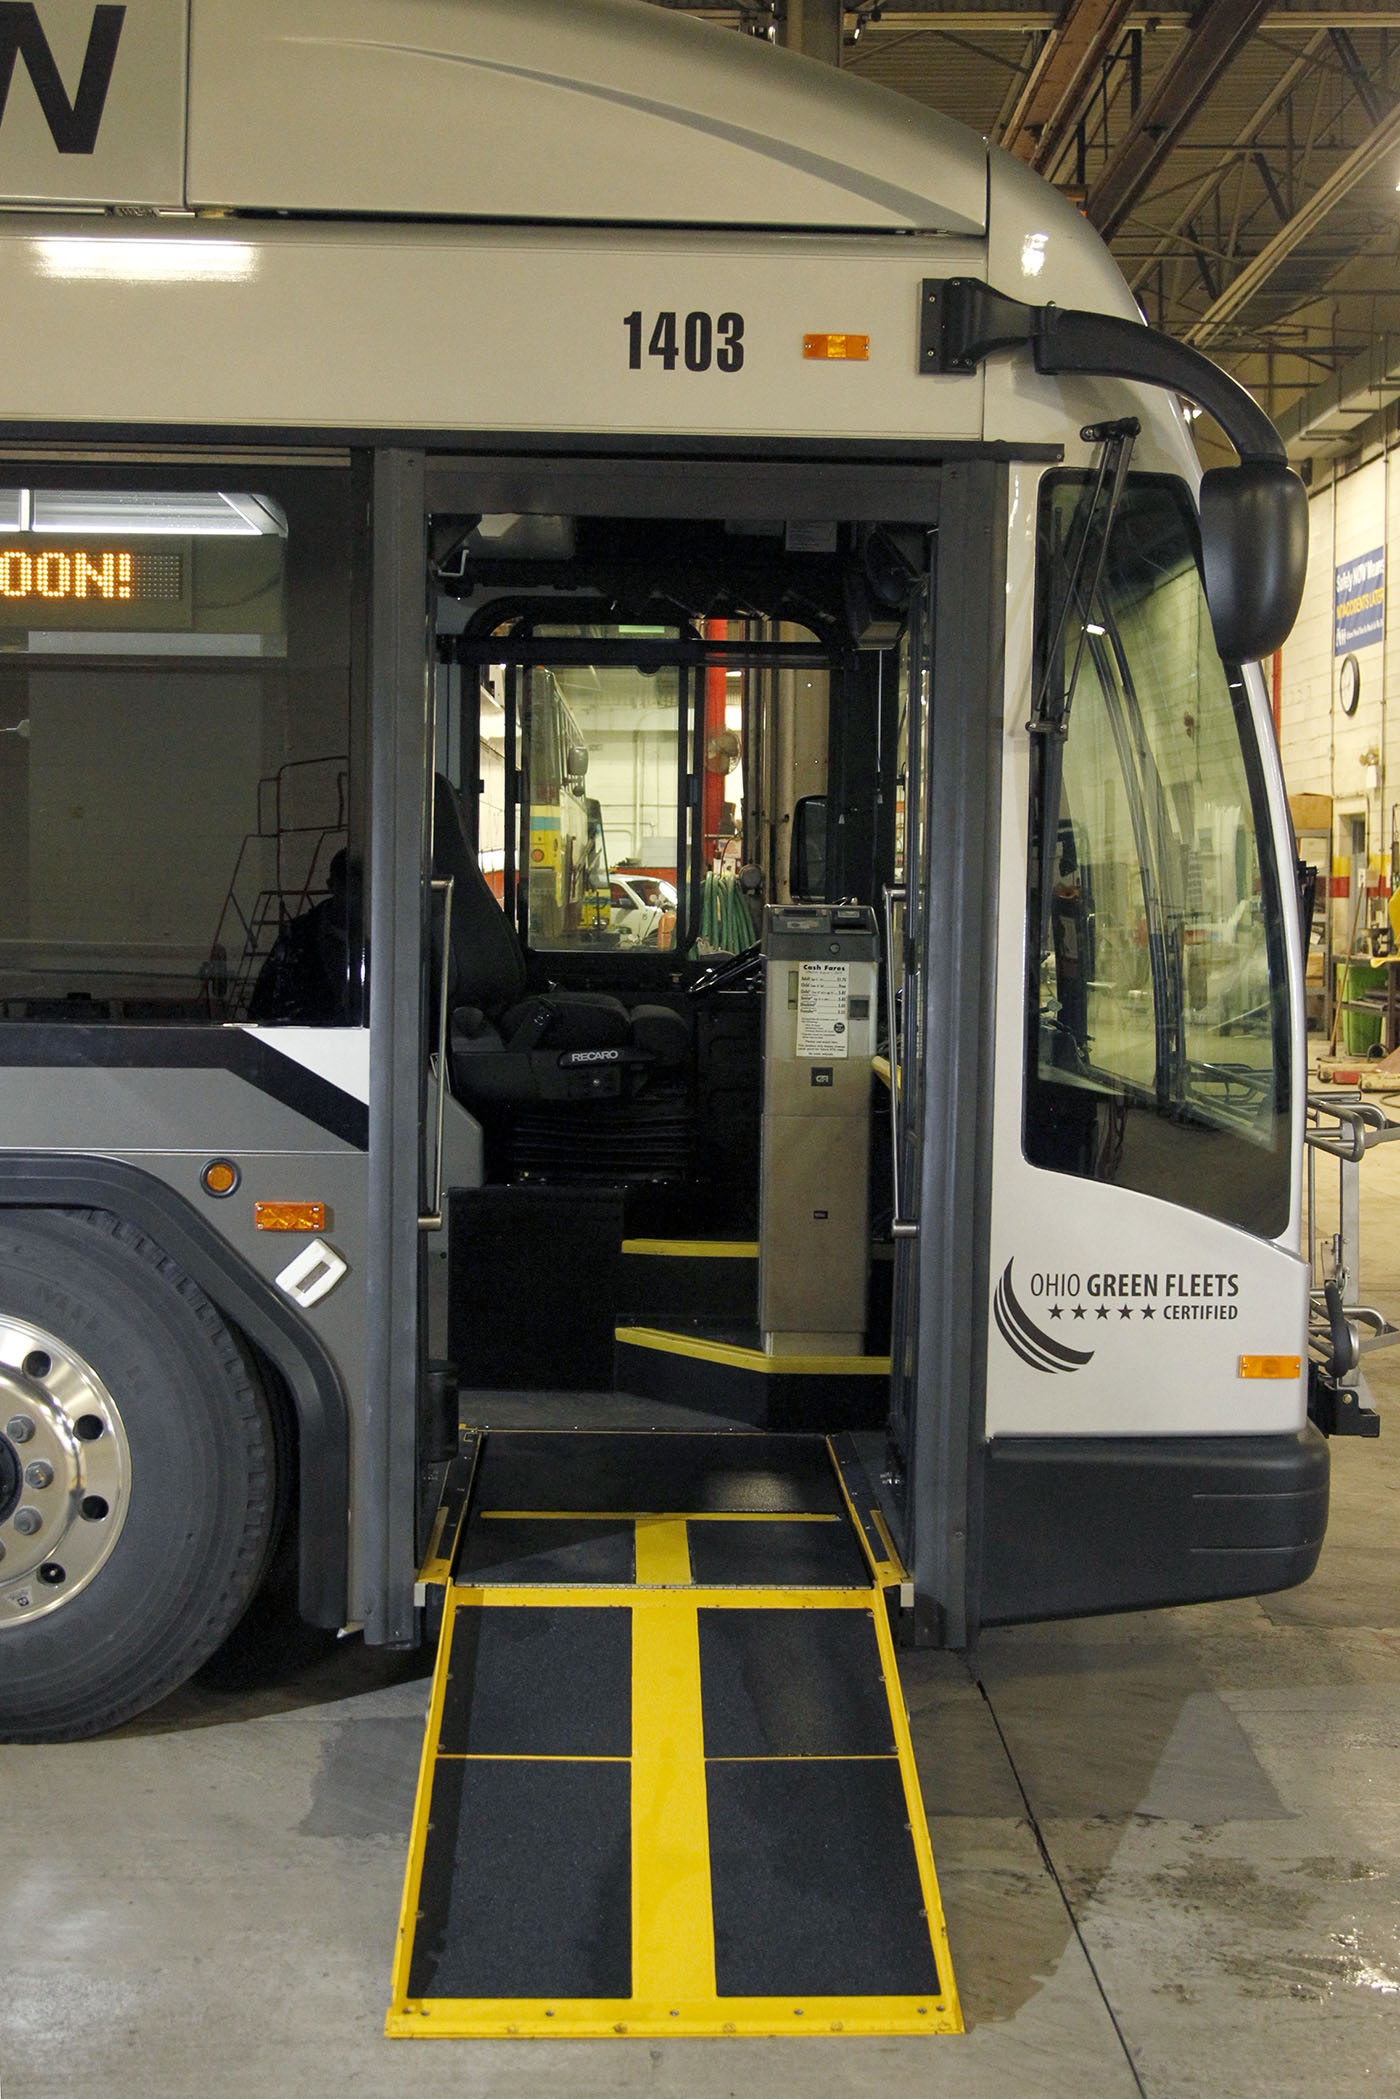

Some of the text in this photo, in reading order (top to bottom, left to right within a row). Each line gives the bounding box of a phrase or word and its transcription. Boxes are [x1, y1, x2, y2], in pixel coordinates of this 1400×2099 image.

[623, 311, 745, 373] 1403
[571, 1050, 619, 1062] RECARO
[1030, 1273, 1239, 1297] OHIO GREEN FLEETS
[1163, 1305, 1238, 1320] CERTIFIED
